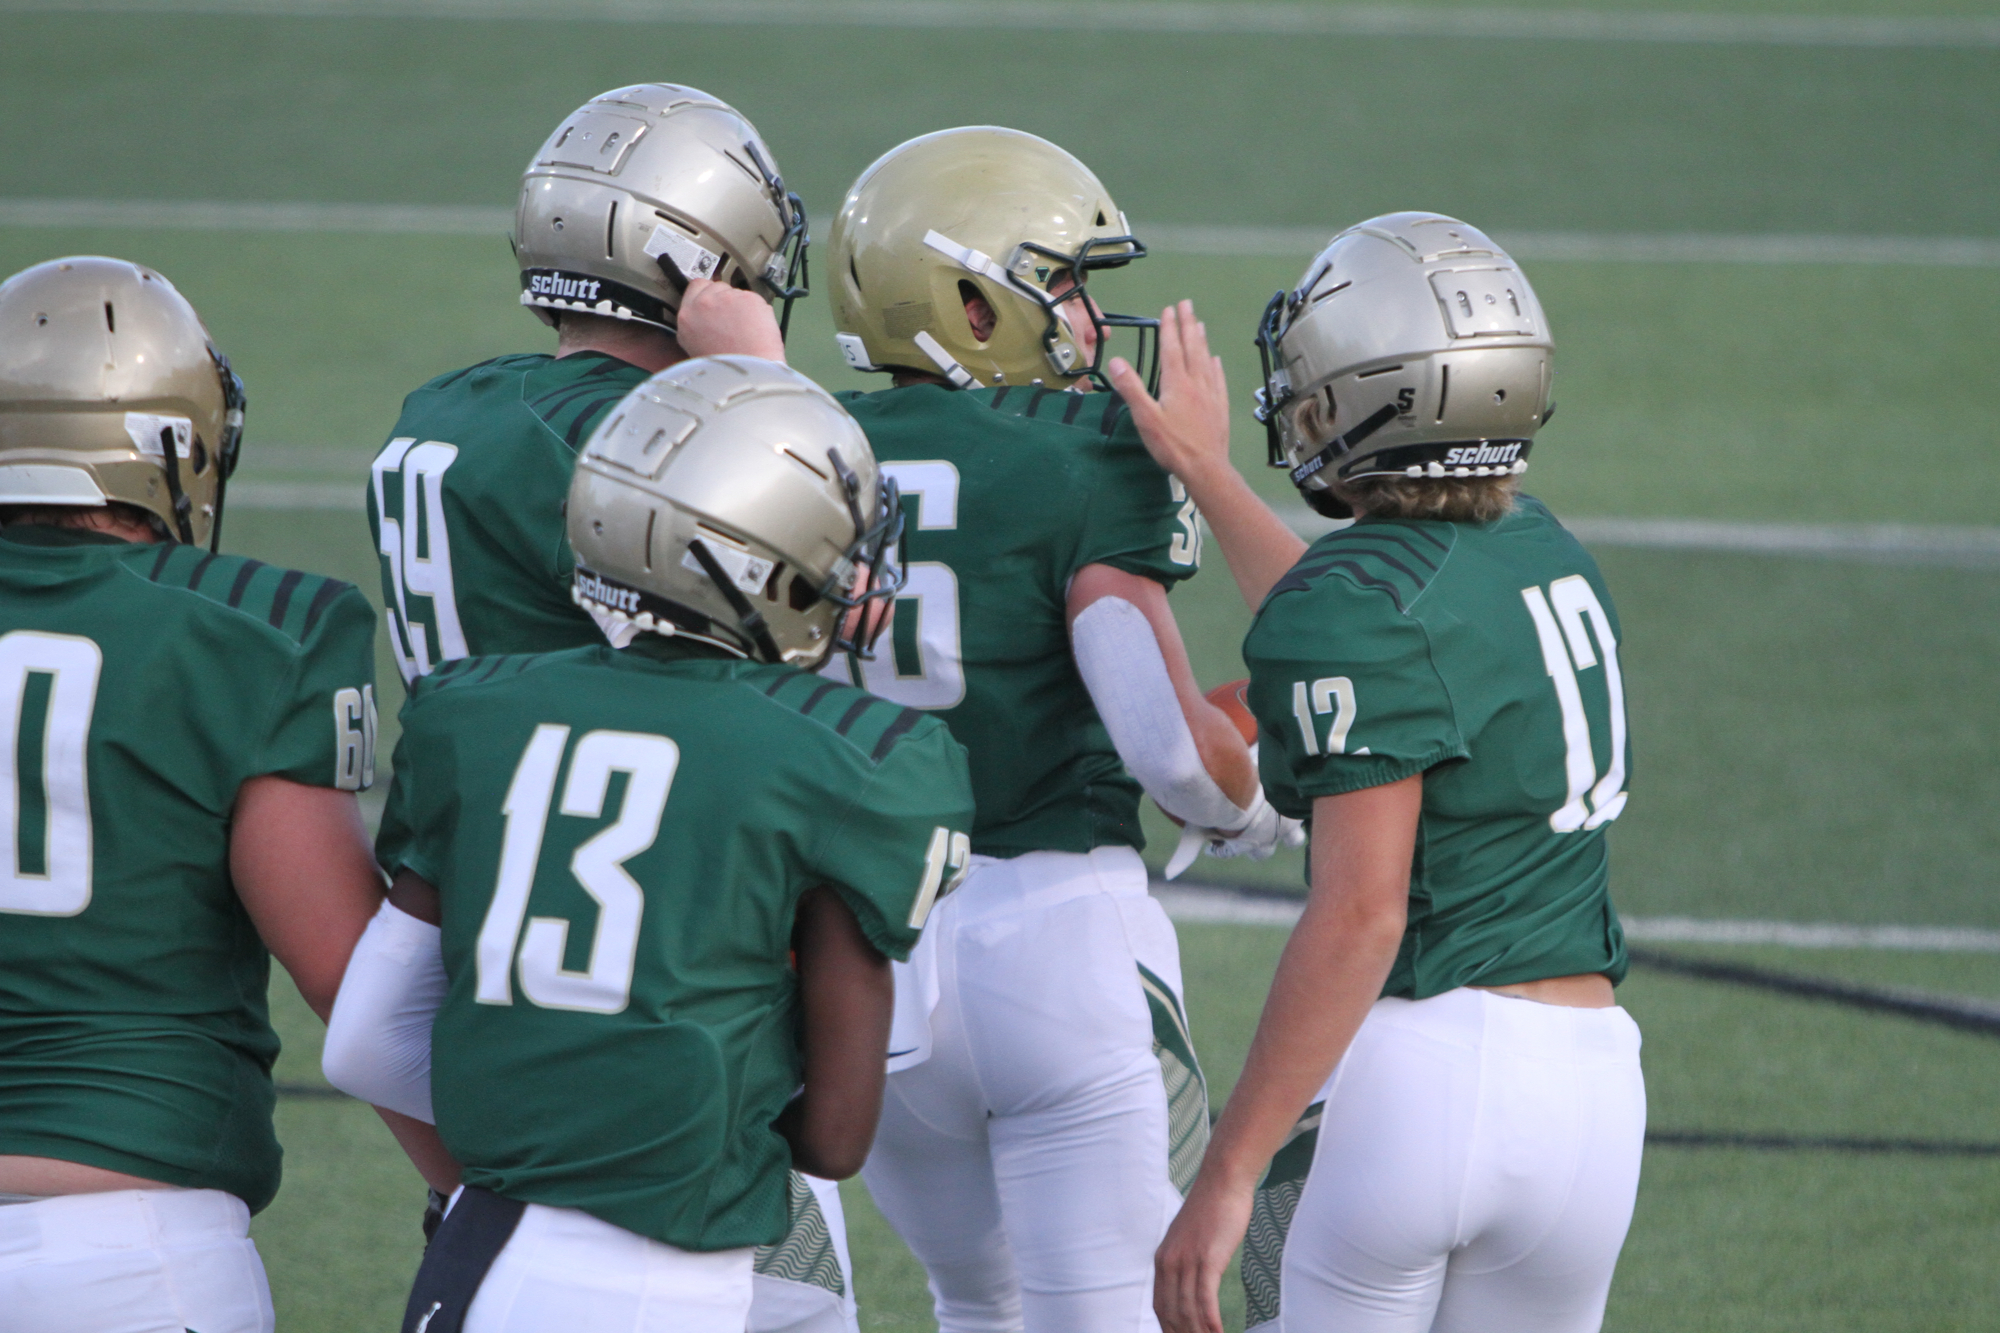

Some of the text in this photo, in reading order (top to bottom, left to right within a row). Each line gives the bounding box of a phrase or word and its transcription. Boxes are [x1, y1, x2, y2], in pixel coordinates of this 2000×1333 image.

[531, 272, 600, 300] schutt
[1294, 455, 1324, 482] schutt
[1445, 442, 1522, 465] schutt
[372, 437, 470, 686] 59
[816, 459, 966, 710] 6
[578, 574, 641, 612] schutt
[1293, 676, 1371, 756] 12
[474, 723, 680, 1014] 13
